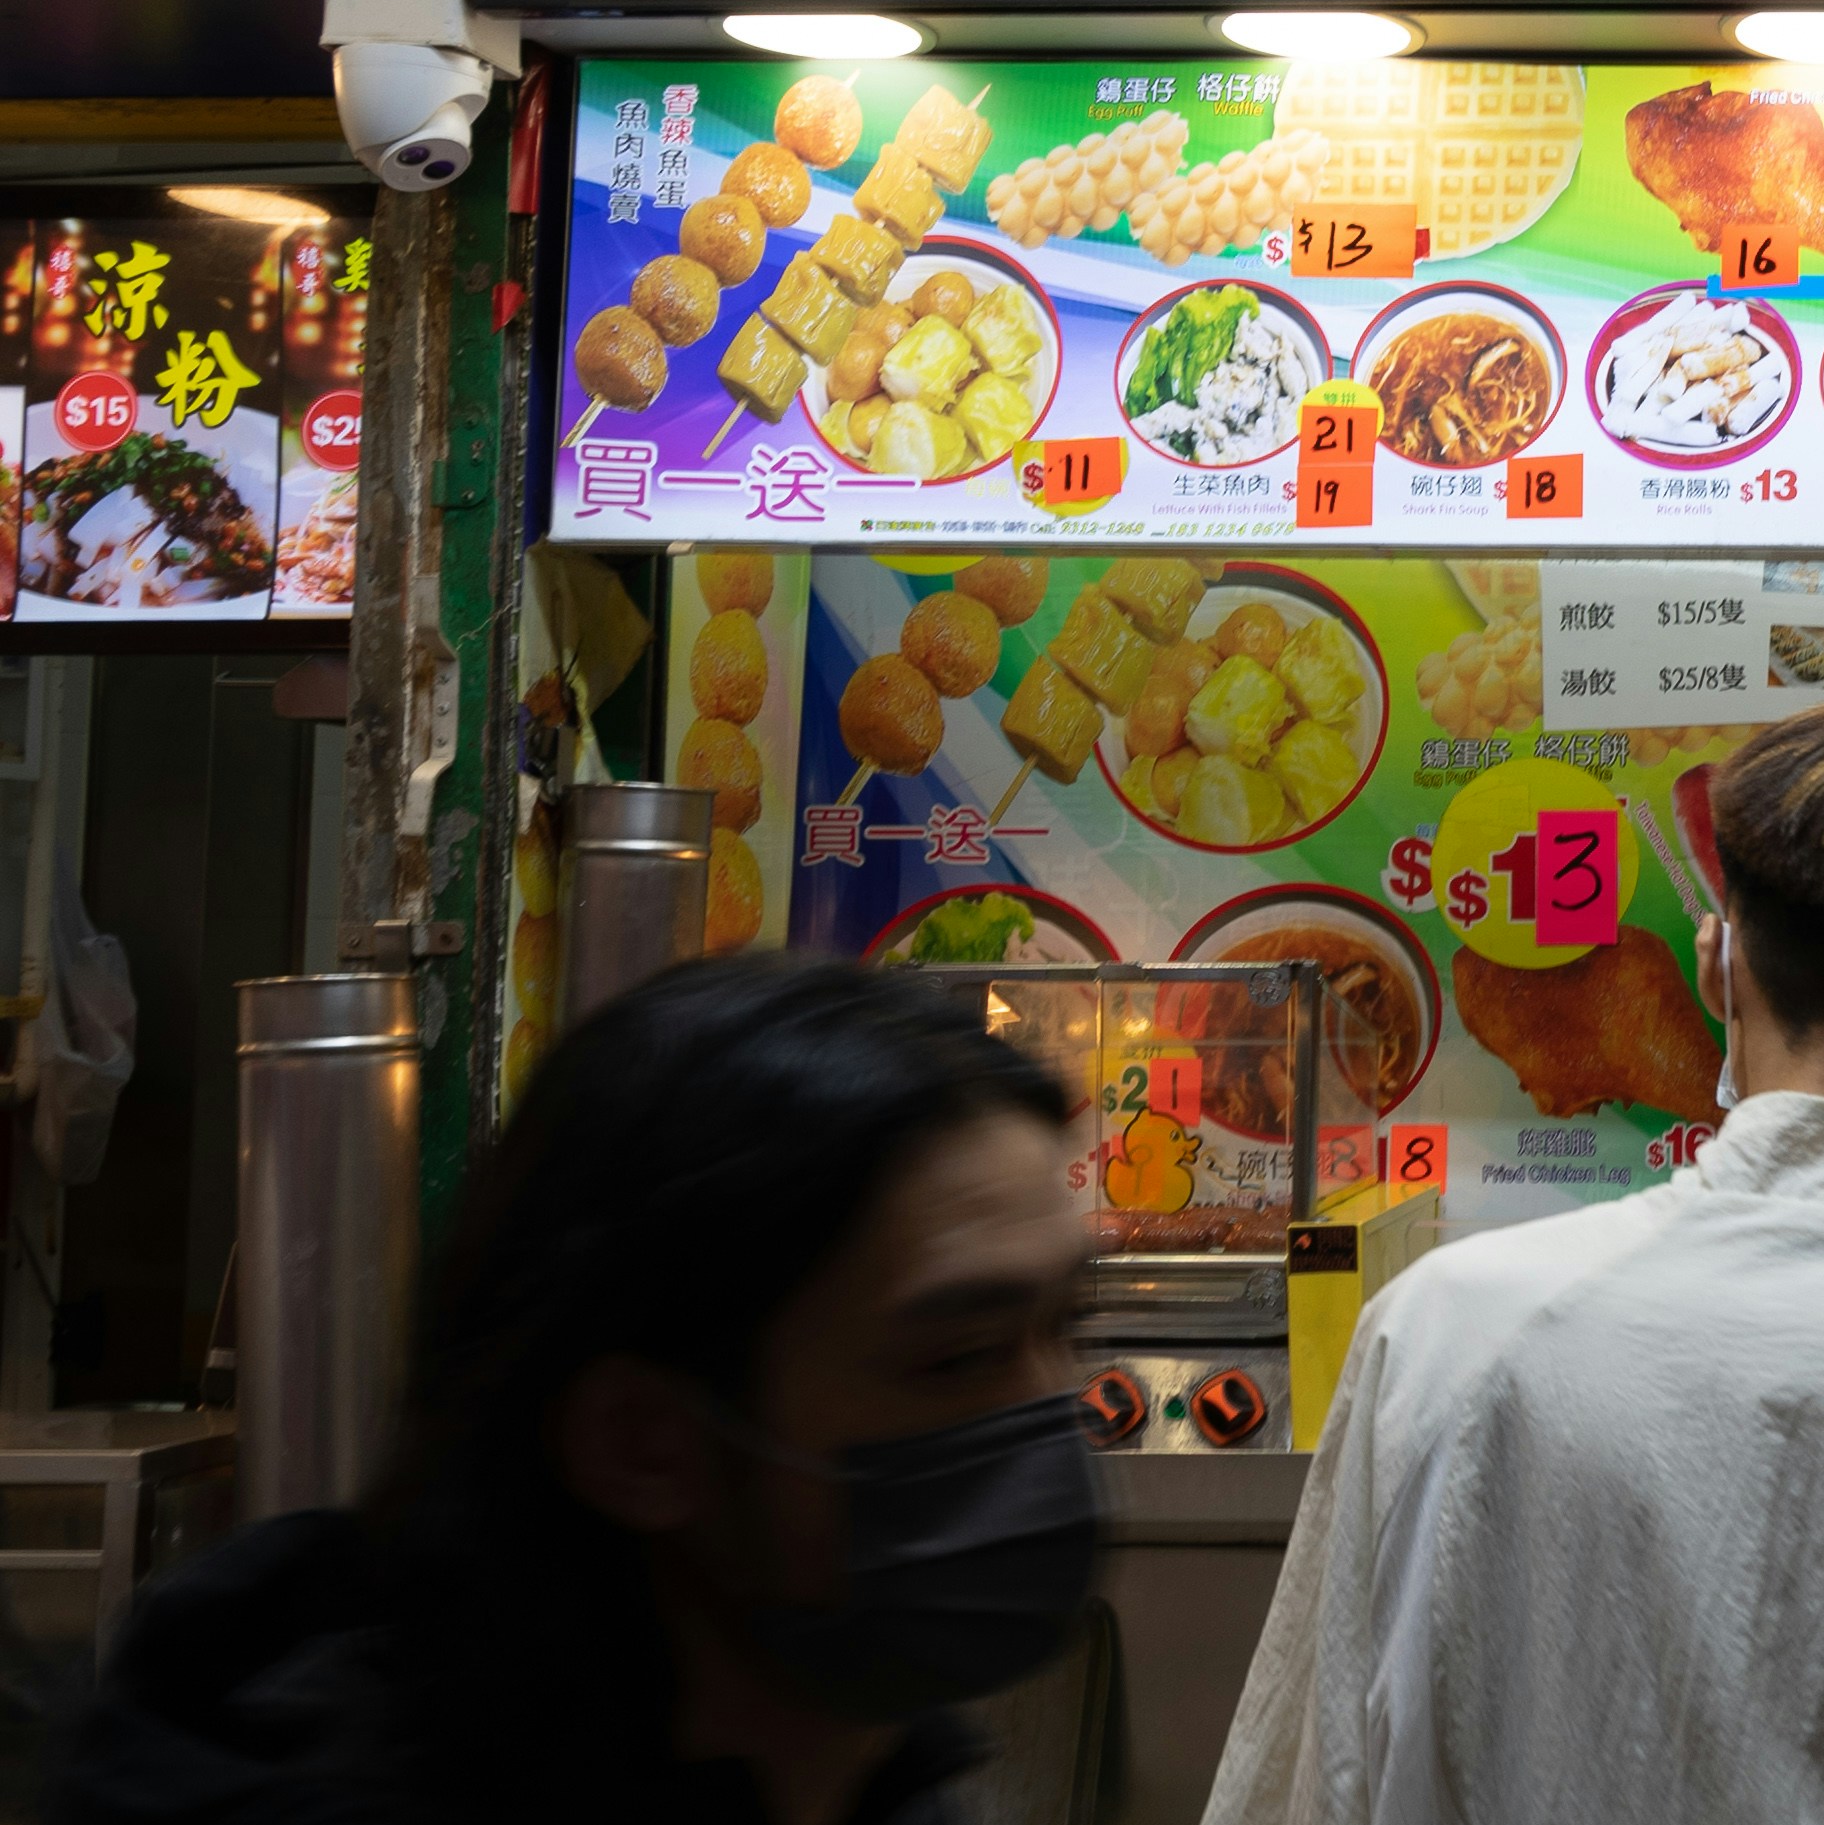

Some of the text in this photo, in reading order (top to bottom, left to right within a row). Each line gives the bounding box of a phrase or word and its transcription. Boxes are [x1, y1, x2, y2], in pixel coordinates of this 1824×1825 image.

[1115, 103, 1144, 117] Puff
[1213, 101, 1264, 117] Waffle
[1750, 89, 1789, 104] Fried
[608, 99, 648, 224] 魚肉燒賣
[654, 84, 699, 209] 香辣魚蛋
[1738, 237, 1777, 278] 16
[84, 240, 261, 429] 涼粉
[65, 396, 130, 427] $15
[1312, 416, 1354, 454] 21
[574, 443, 918, 522] 買一送一
[1172, 474, 1271, 497] 生菜魚肉
[1315, 480, 1340, 513] 19
[1410, 474, 1484, 497] 碗仔翅
[1525, 470, 1556, 508] 18
[1640, 476, 1731, 499] 香滑腸粉
[1740, 469, 1799, 503] $13
[1152, 503, 1288, 515] Lettuce With Fish Fillets
[1402, 503, 1489, 517] Shark Fin Soup
[1657, 503, 1713, 516] Rice Rolls
[1560, 597, 1746, 631] 煎餃 $15/5隻
[1561, 663, 1747, 697] 湯餃 $25/8隻
[802, 806, 1049, 865] 買一送一
[1552, 831, 1602, 911] 3
[1103, 1065, 1148, 1114] $2
[1482, 1163, 1632, 1188] Fried Chicken Leg
